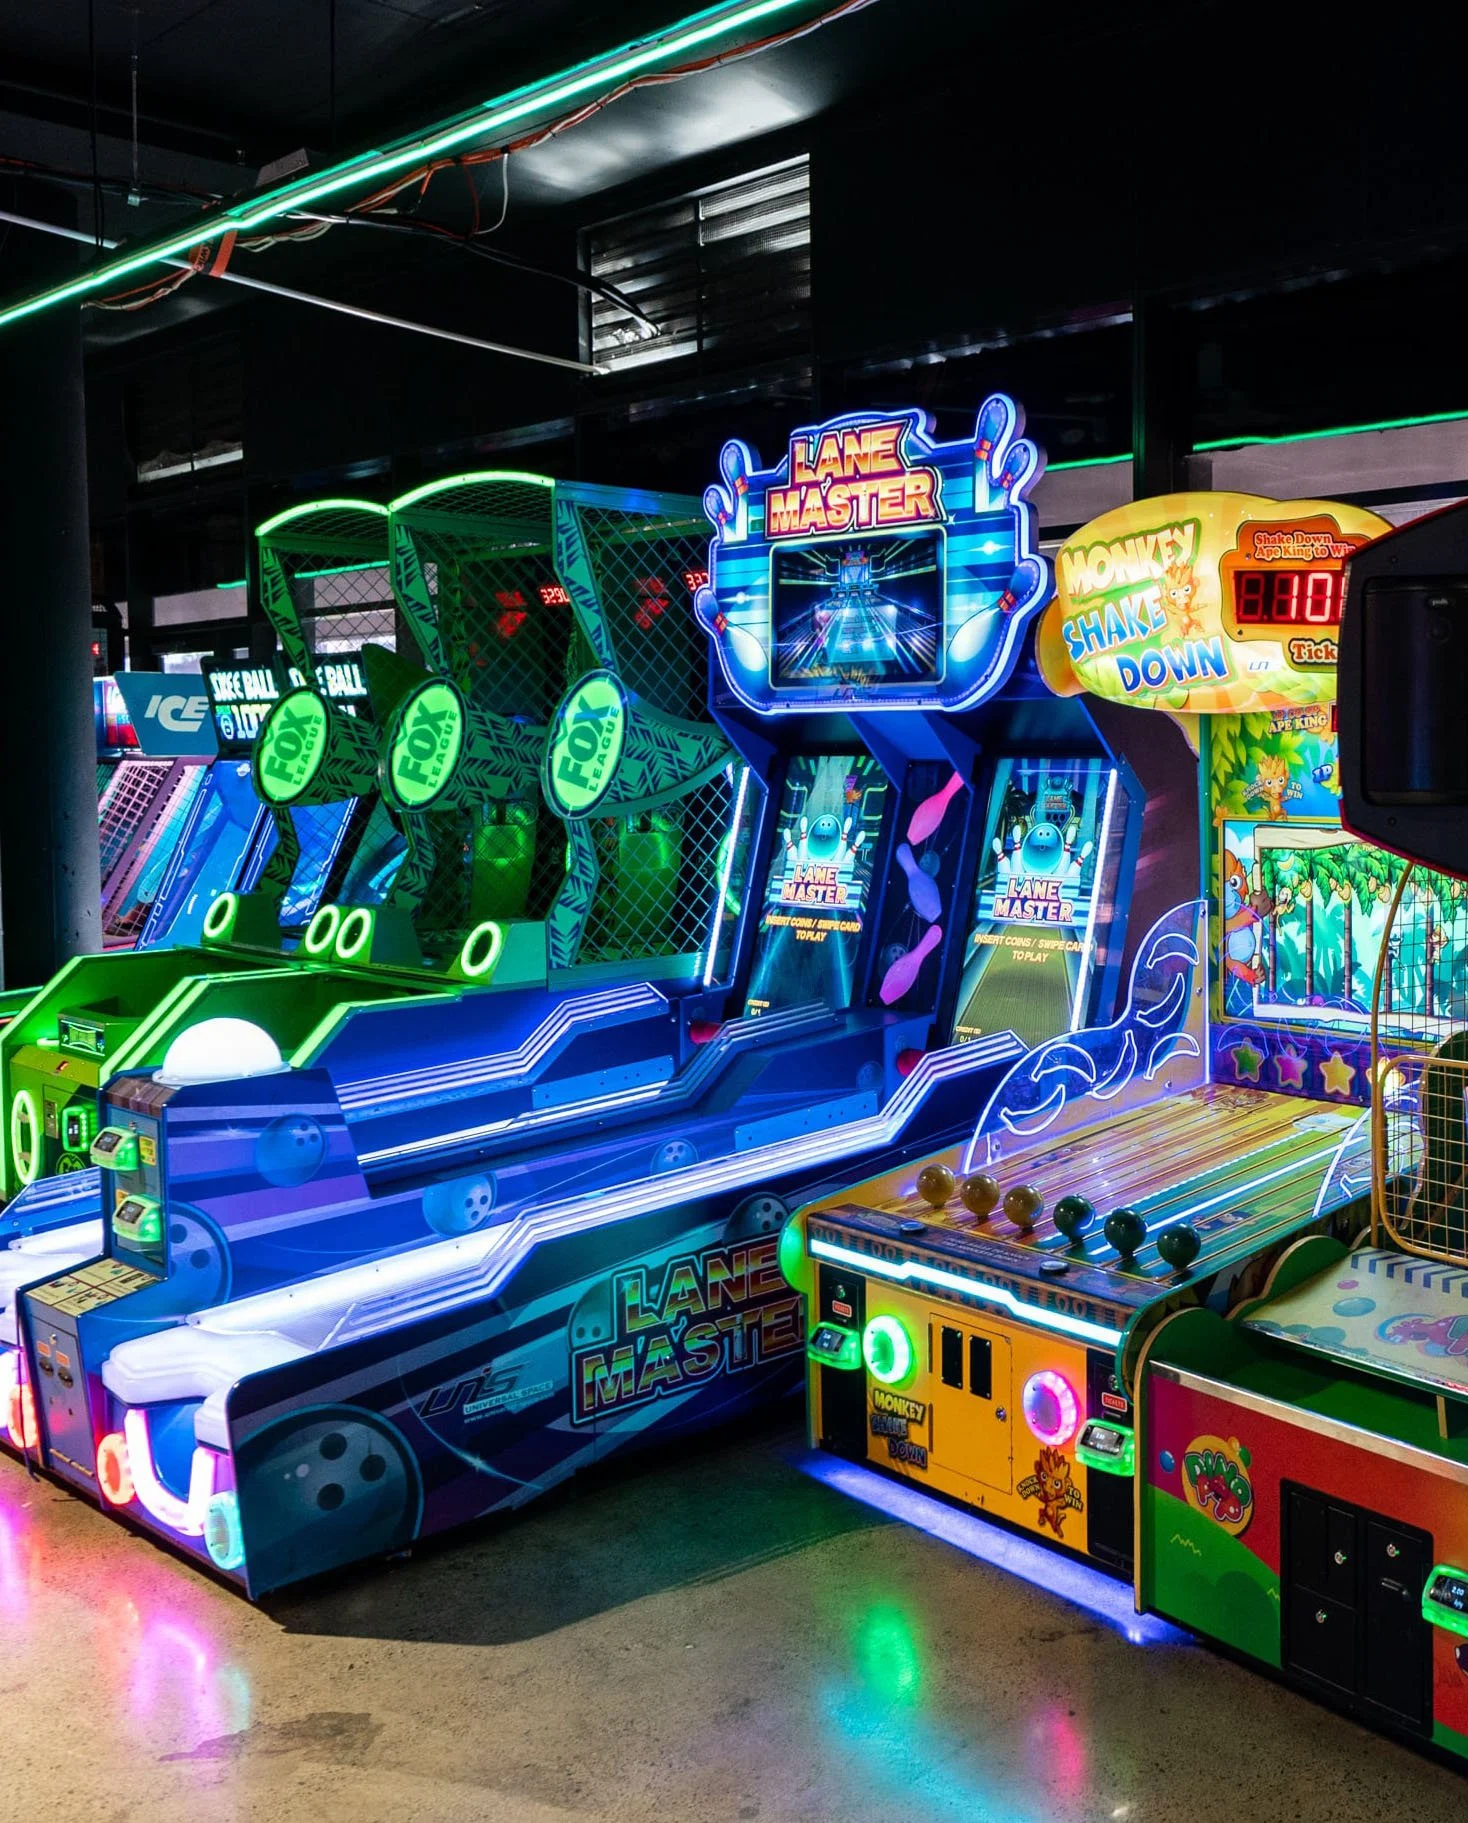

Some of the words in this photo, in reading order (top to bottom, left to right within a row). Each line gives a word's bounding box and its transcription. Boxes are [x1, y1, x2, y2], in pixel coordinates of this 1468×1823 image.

[793, 424, 904, 484] LANE
[768, 472, 933, 532] MASTER
[1255, 533, 1292, 545] Shake
[1294, 533, 1332, 545] Down
[1255, 546, 1281, 559] Ape
[1282, 546, 1312, 559] King
[1314, 547, 1329, 557] to
[1061, 522, 1197, 597] MONKEY
[1062, 586, 1168, 661] SHAKE
[1116, 636, 1230, 693] DOWN
[242, 669, 279, 699] BALL
[324, 664, 367, 697] BALL
[144, 695, 210, 732] ICE
[1268, 719, 1293, 733] APE
[1295, 715, 1328, 730] KING
[264, 706, 315, 783] FOX
[293, 715, 322, 785] LEAGUE
[397, 700, 448, 785] FOX
[428, 710, 457, 788] LEAGUE
[557, 694, 610, 789] FOX
[589, 706, 619, 792] LEAGUE
[1287, 788, 1303, 799] WIN
[1291, 781, 1302, 790] TO
[794, 865, 839, 884] LANE
[1008, 877, 1062, 900] LANE
[782, 884, 846, 904] MASTER
[994, 898, 1073, 922] MASTER
[796, 930, 806, 940] TO
[806, 931, 827, 942] PLAY
[840, 922, 861, 932] CARD
[974, 933, 1005, 945] INSERT
[1003, 936, 1032, 948] COINS
[1038, 939, 1065, 950] SWIPE
[1012, 950, 1025, 960] TO
[1025, 951, 1049, 962] PLAY
[624, 1243, 788, 1334] LANE
[582, 1296, 805, 1412] MASTE
[874, 1390, 924, 1422] MONKEY
[889, 1438, 927, 1468] DOWN
[1068, 1486, 1080, 1498] TO
[1185, 1449, 1252, 1508] DINO
[1064, 1494, 1082, 1510] WIN
